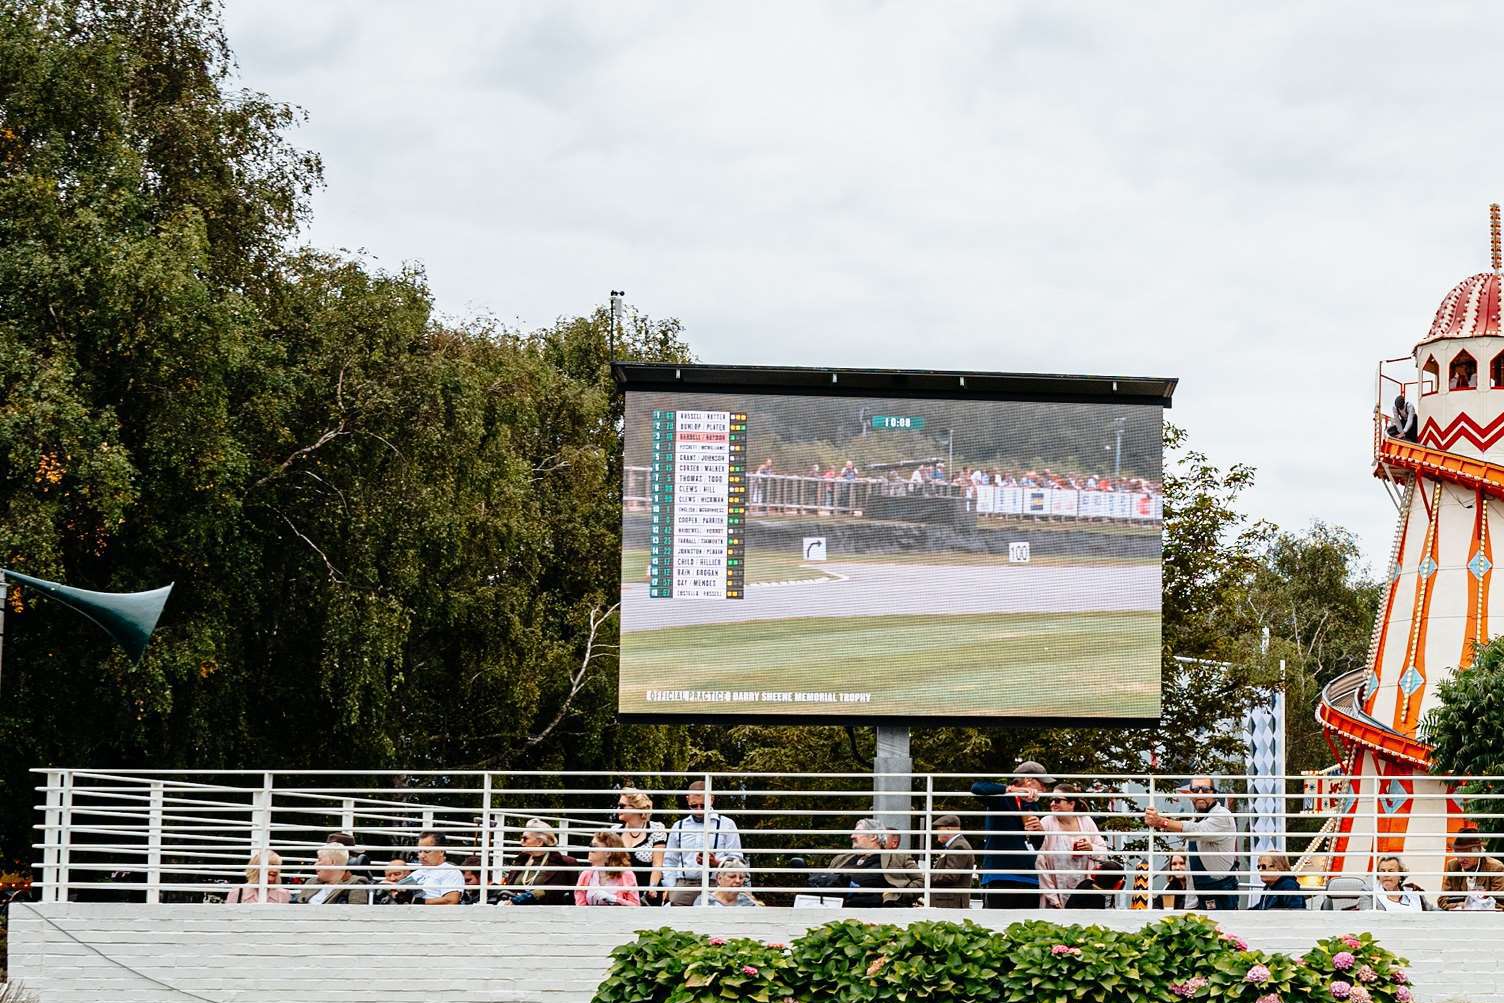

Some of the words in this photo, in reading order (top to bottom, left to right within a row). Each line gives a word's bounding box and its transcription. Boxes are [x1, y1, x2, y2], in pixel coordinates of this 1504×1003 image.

[708, 475, 723, 483] TODD
[679, 485, 698, 493] CLEWS
[1011, 545, 1026, 560] 100
[693, 579, 716, 587] MENDES
[794, 692, 838, 702] MEMORIAL
[839, 693, 871, 702] TROPHY
